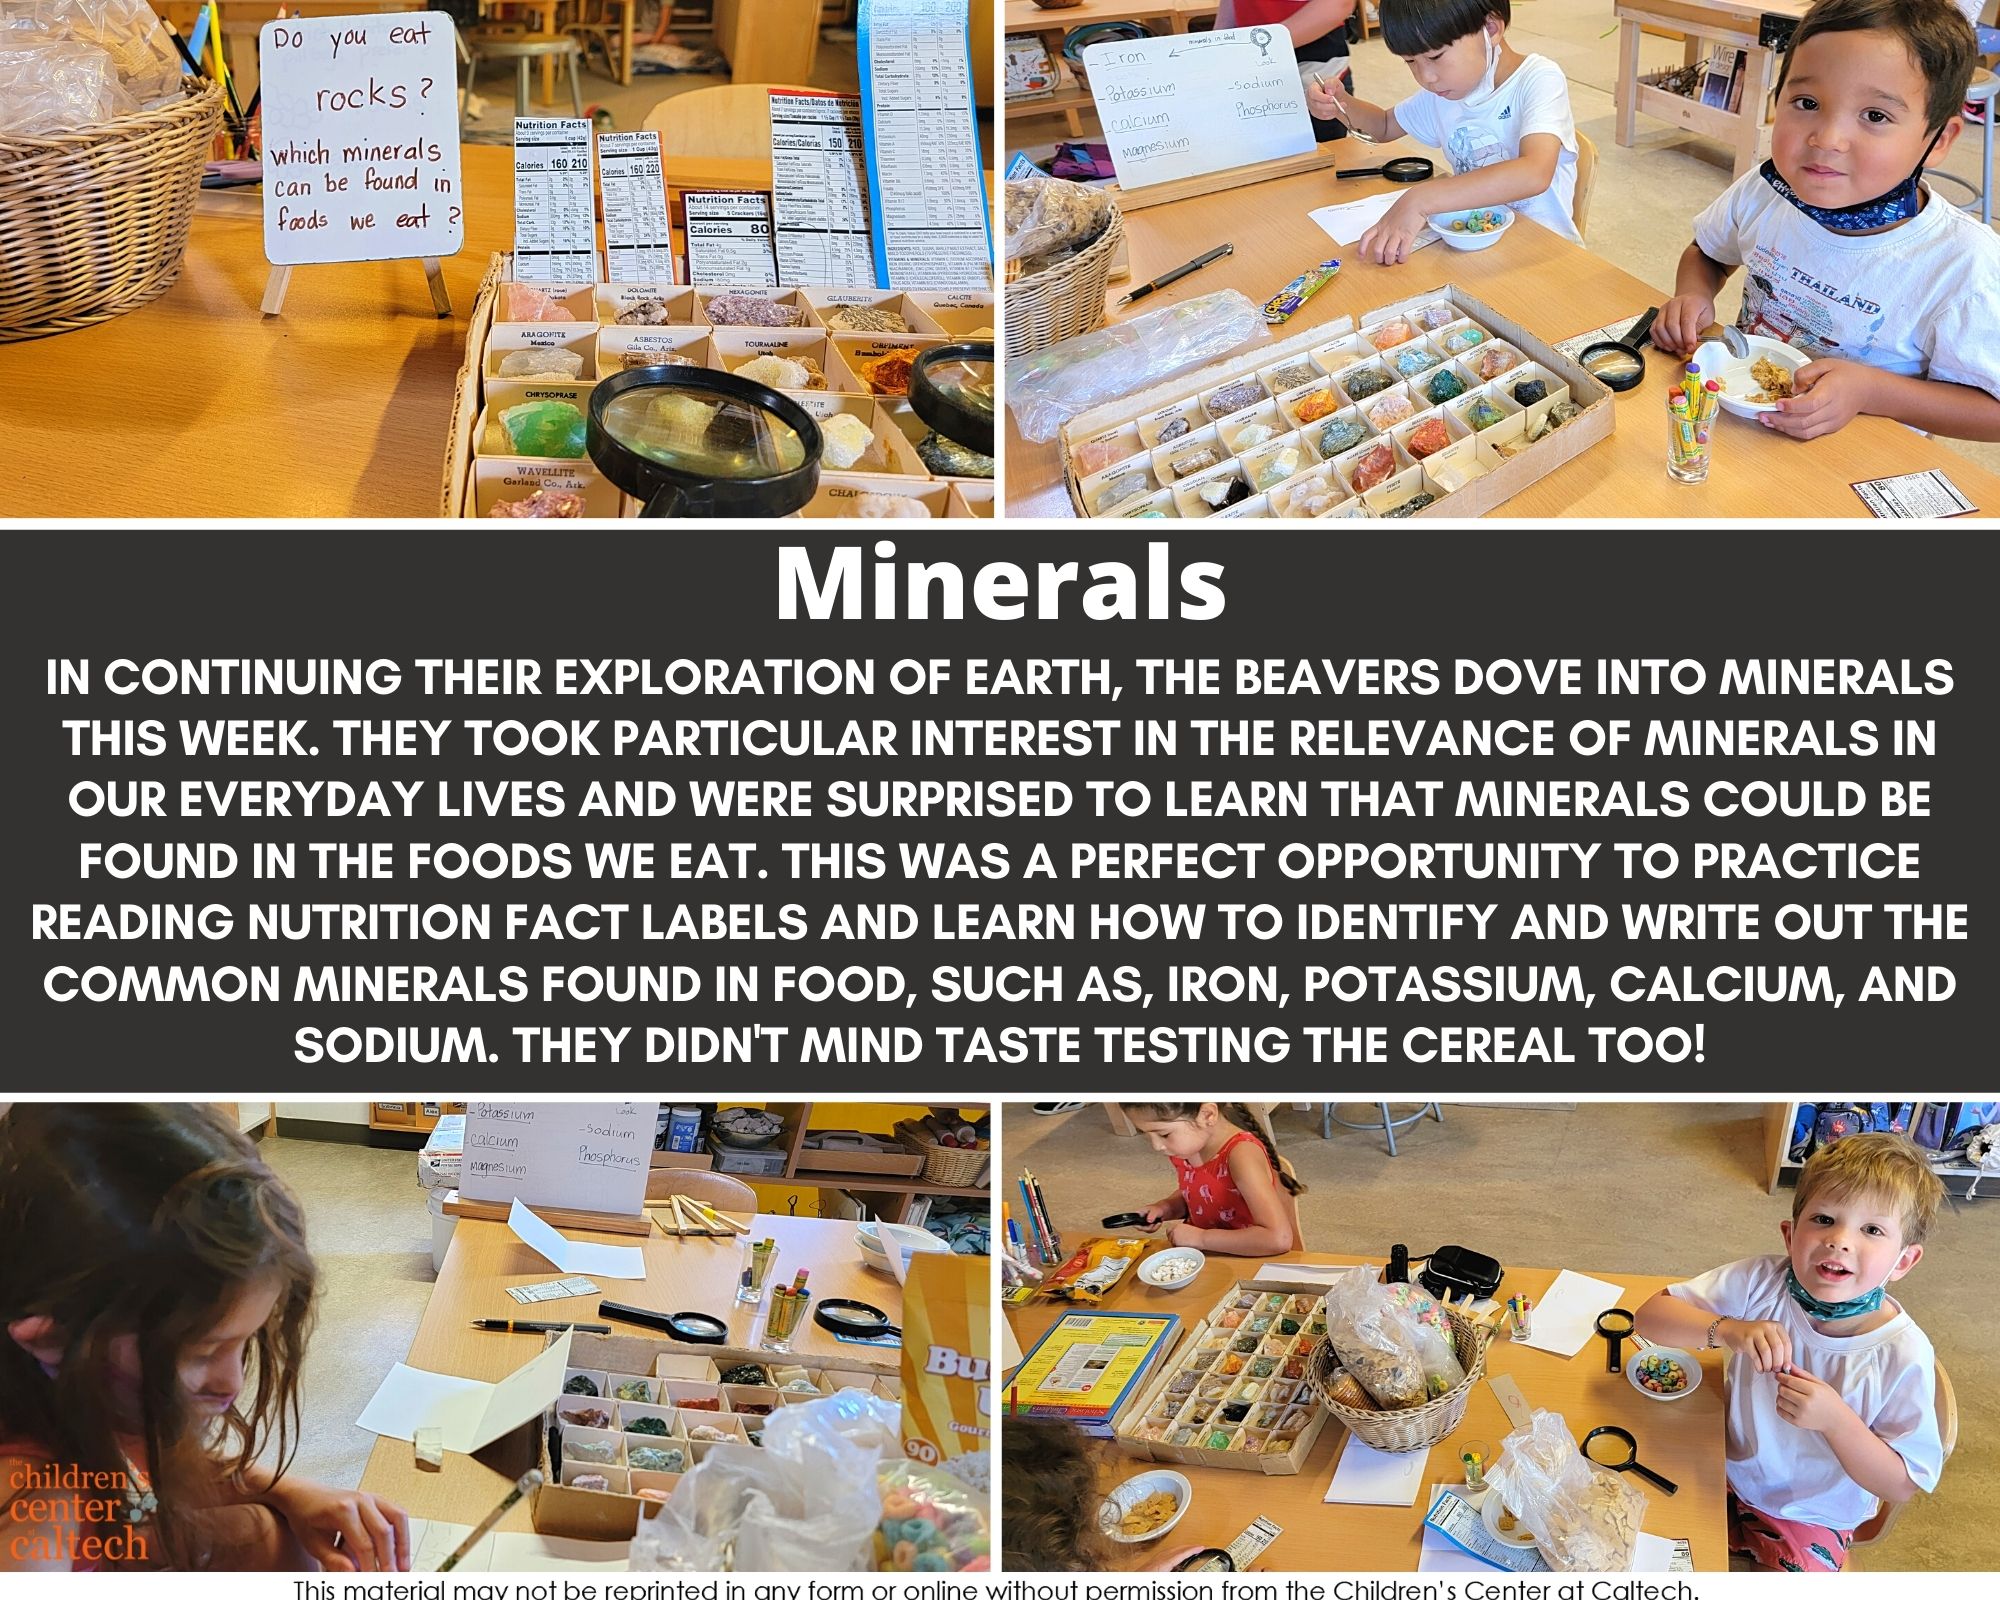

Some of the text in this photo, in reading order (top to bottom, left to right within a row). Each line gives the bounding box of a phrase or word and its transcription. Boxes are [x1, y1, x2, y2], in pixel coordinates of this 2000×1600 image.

[274, 21, 432, 59] Do you eat
[1100, 50, 1146, 67] Iron
[1712, 44, 1735, 64] Wire
[1106, 78, 1176, 101] Potassium
[1235, 98, 1299, 119] Phosphorus
[516, 121, 587, 129] Nutrition Facts
[599, 133, 657, 142] Nutrition Facts
[829, 137, 842, 148] 150
[848, 138, 862, 148] 210
[270, 138, 442, 166] which minerals
[516, 158, 587, 170] Calories 160 210
[602, 163, 660, 176] Calories 160 220
[275, 167, 451, 197] can be found in
[688, 196, 766, 204] Nutrition Facts
[278, 206, 328, 231] foods
[350, 213, 375, 231] we
[690, 224, 770, 234] Calories 80
[1790, 267, 1881, 315] THAILAND
[827, 295, 873, 303] GLAUBERITE
[525, 391, 578, 399] CHRYSOPRASE
[517, 467, 575, 477] WAVELLITE
[503, 478, 540, 486] Garland
[565, 480, 586, 489] Ark.
[578, 1145, 641, 1168] Phosphorus
[906, 1440, 937, 1463] 90
